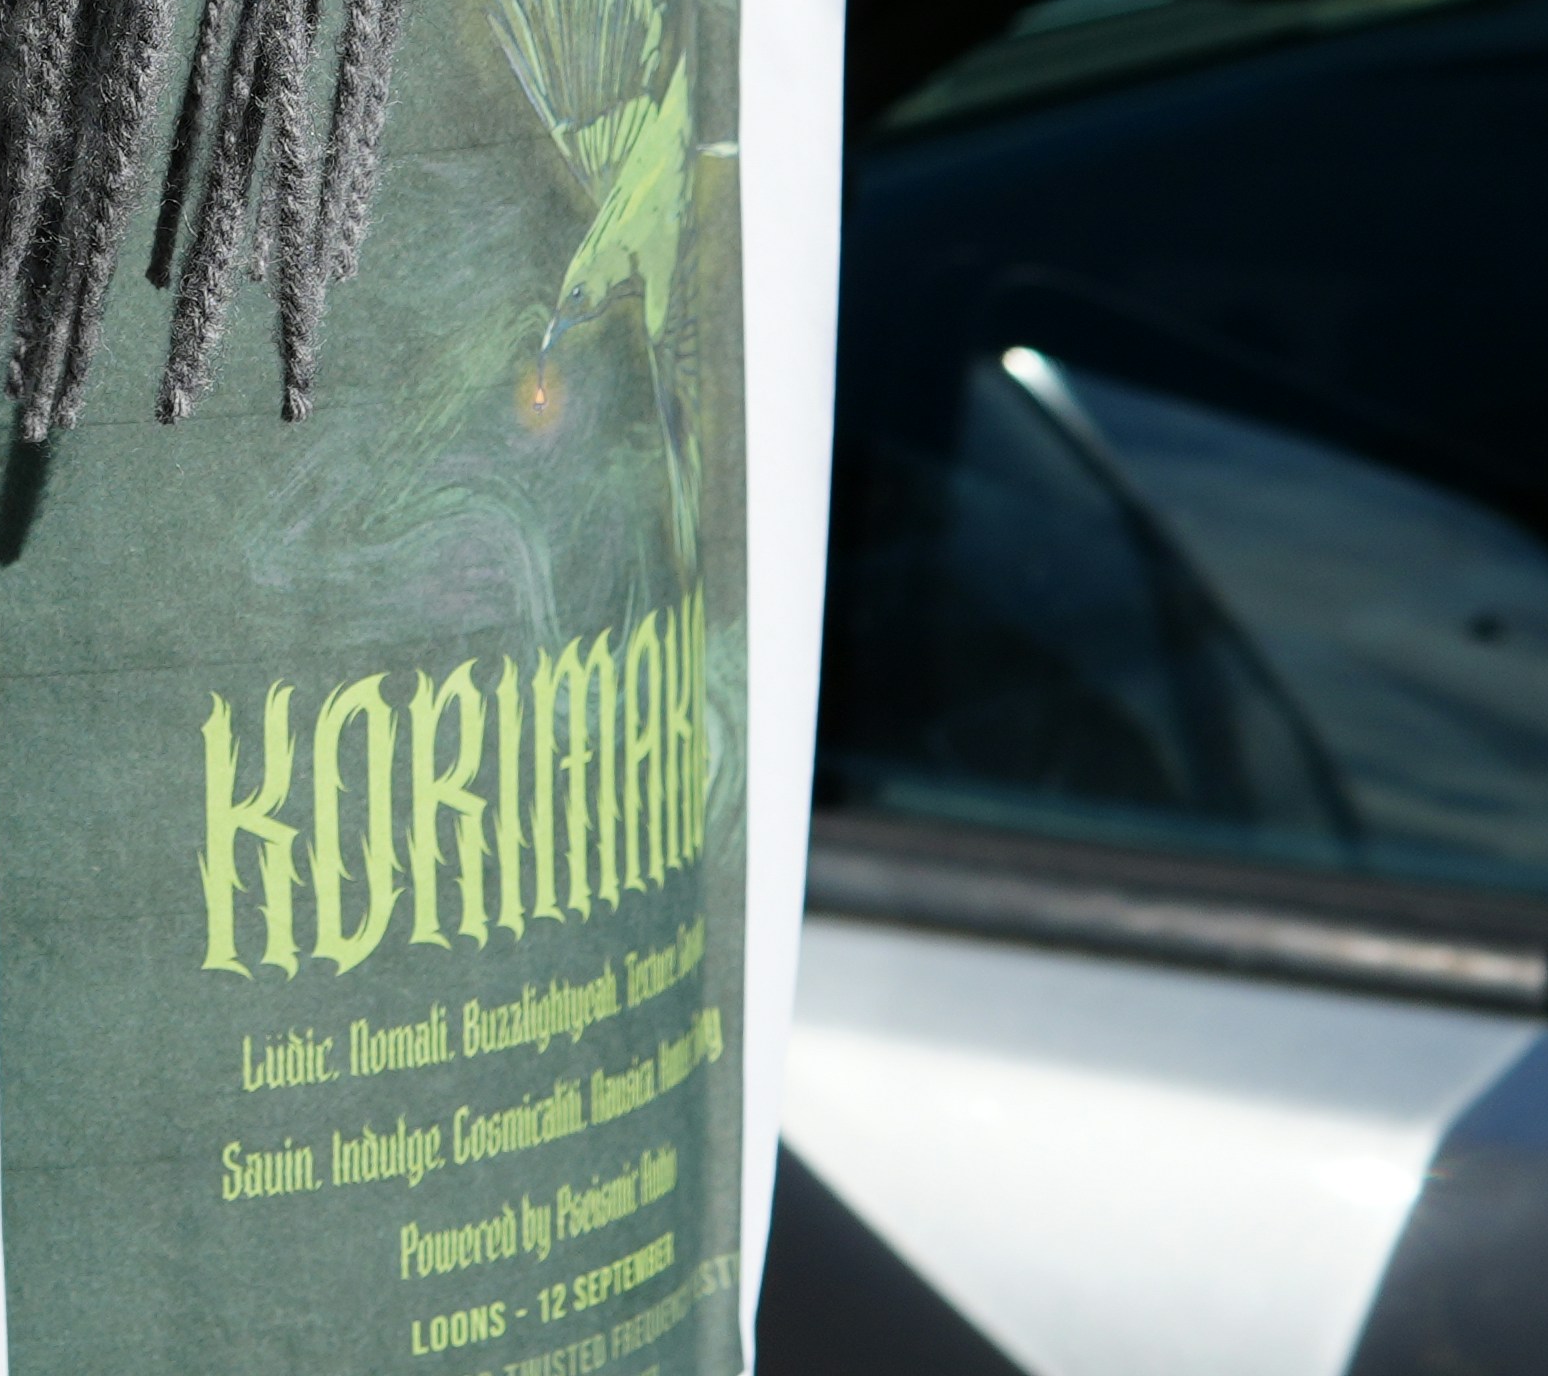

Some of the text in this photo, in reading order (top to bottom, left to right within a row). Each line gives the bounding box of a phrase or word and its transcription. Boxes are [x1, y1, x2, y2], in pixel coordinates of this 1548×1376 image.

[399, 1201, 517, 1281] Powered
[521, 1193, 551, 1263] by
[411, 1300, 507, 1356] LOONS
[537, 1282, 568, 1323] 12
[572, 1231, 675, 1312] SEPTEMBER
